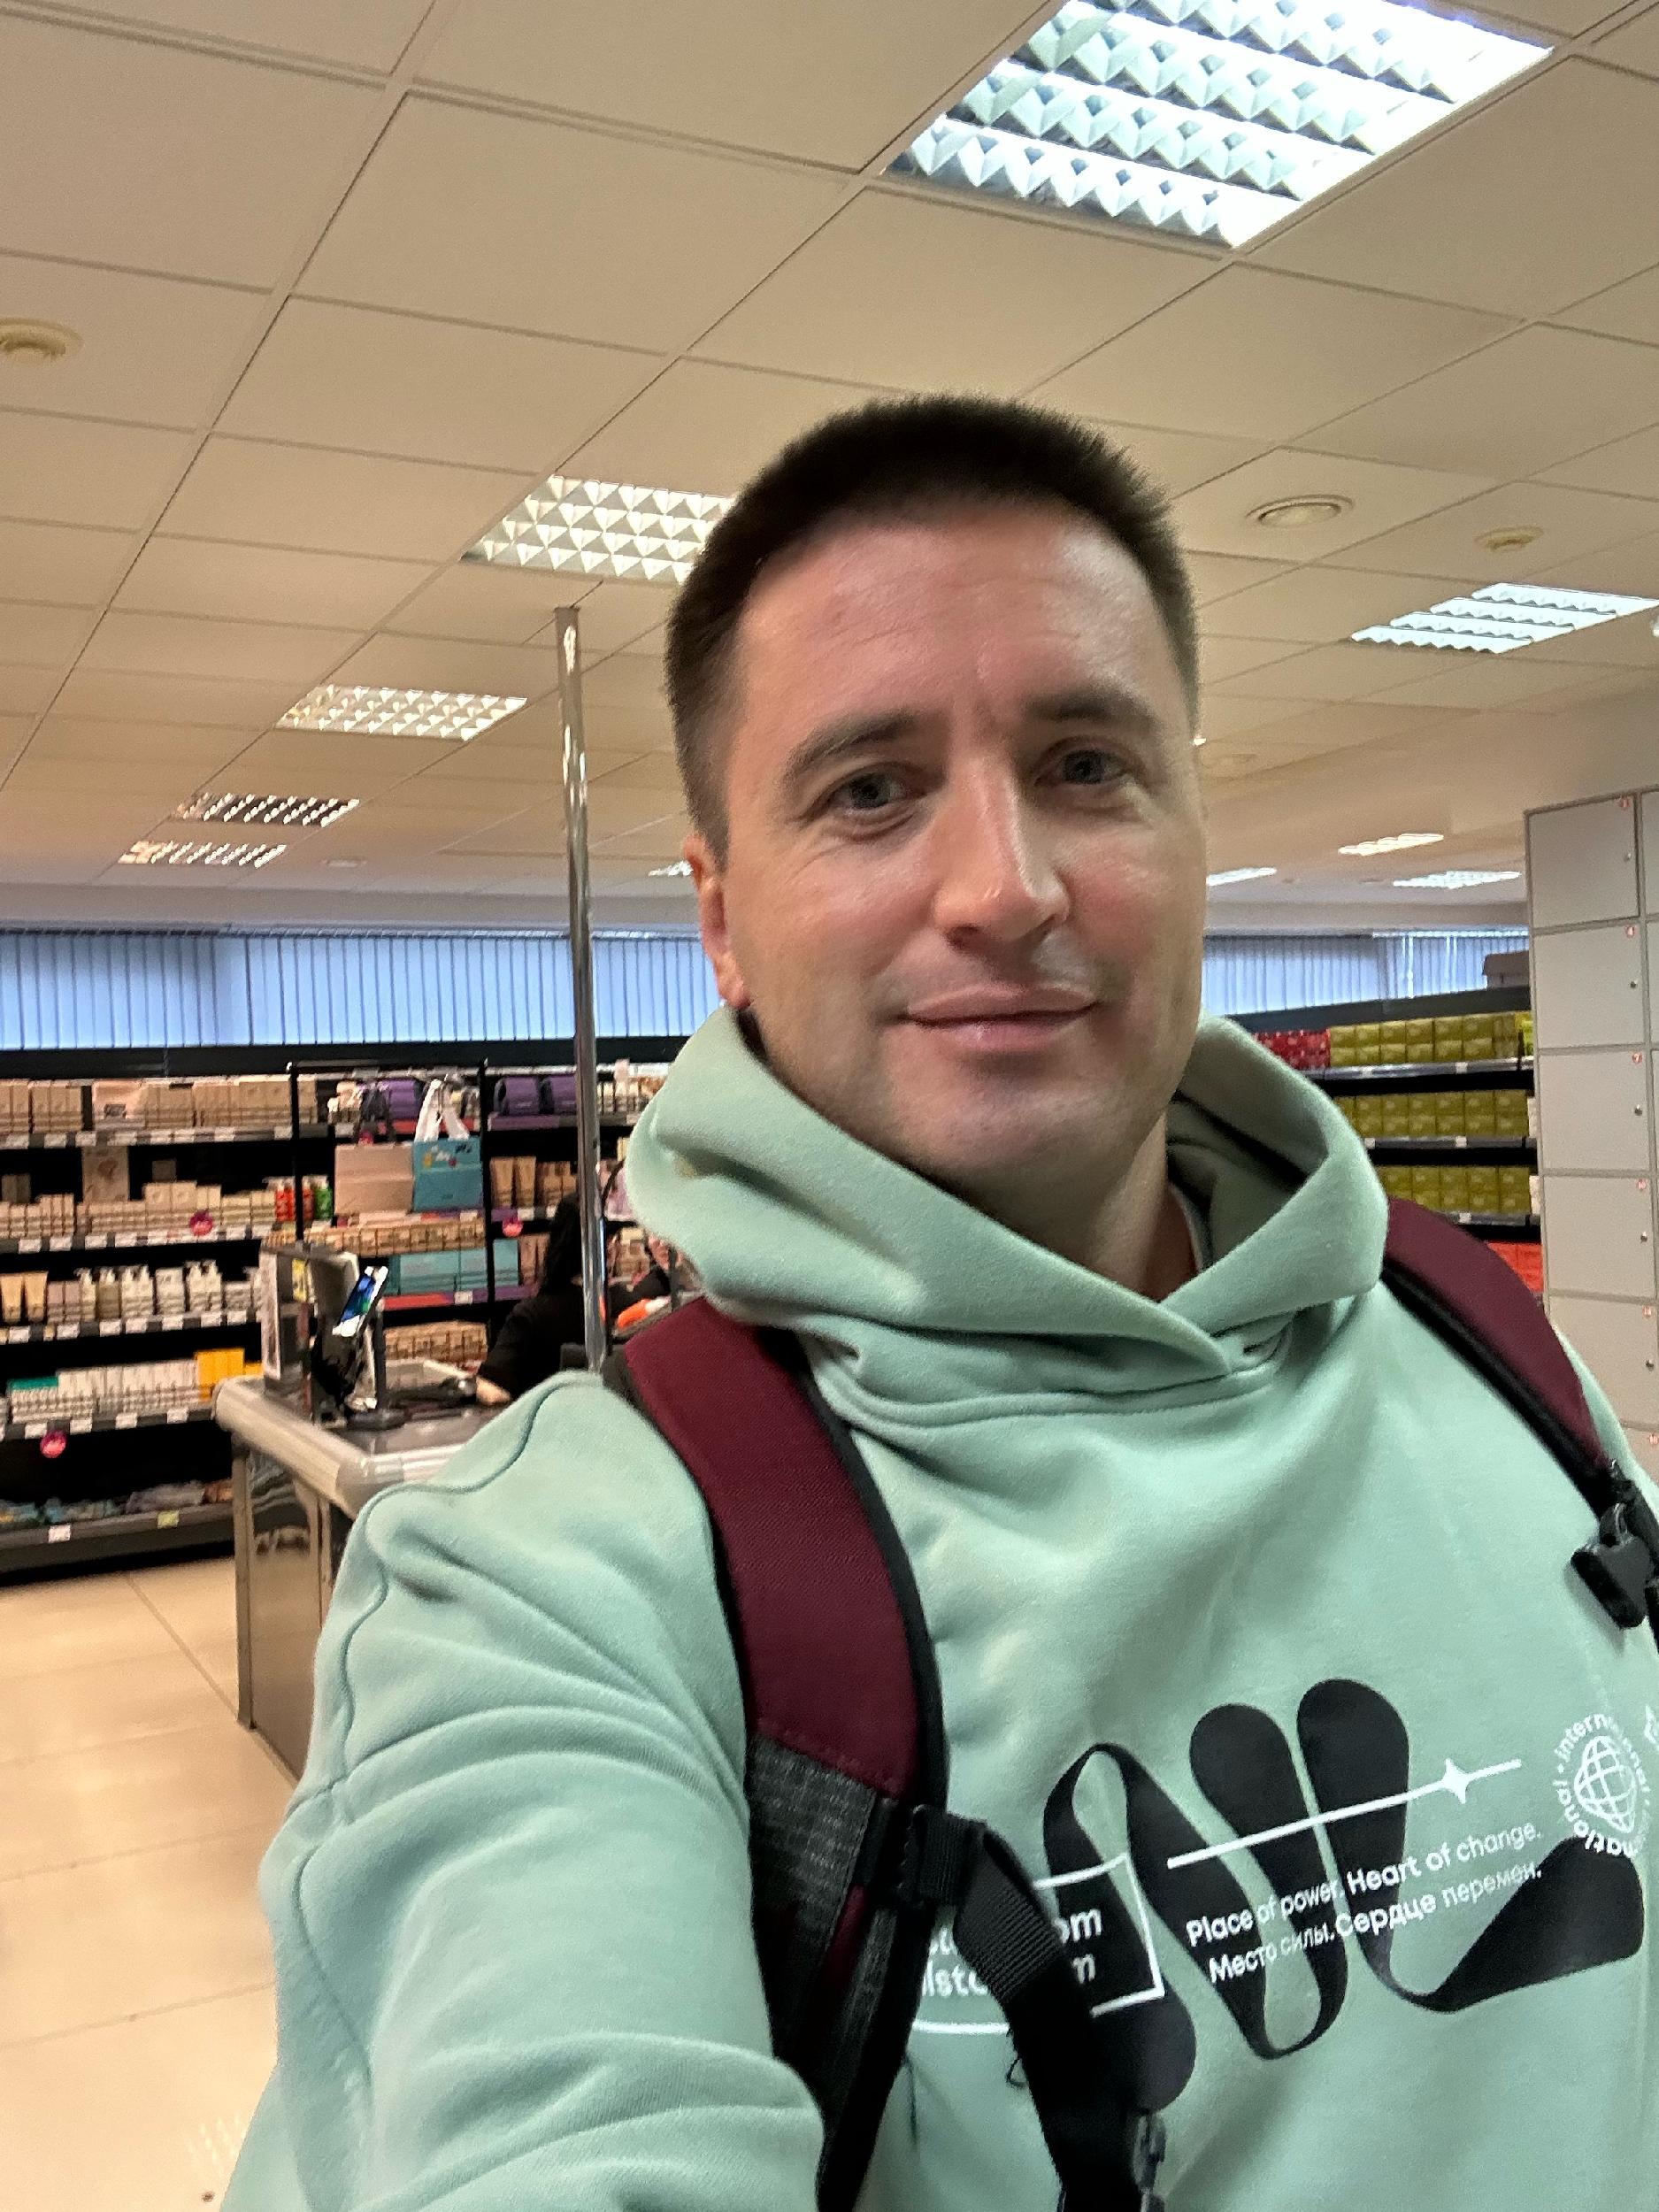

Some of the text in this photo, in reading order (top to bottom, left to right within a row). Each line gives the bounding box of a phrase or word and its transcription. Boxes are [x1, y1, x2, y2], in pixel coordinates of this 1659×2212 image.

[1186, 1822, 1542, 1947] Place of power. Heart of change.
[1208, 1861, 1542, 1984] Место силы. Сердце перемен.
